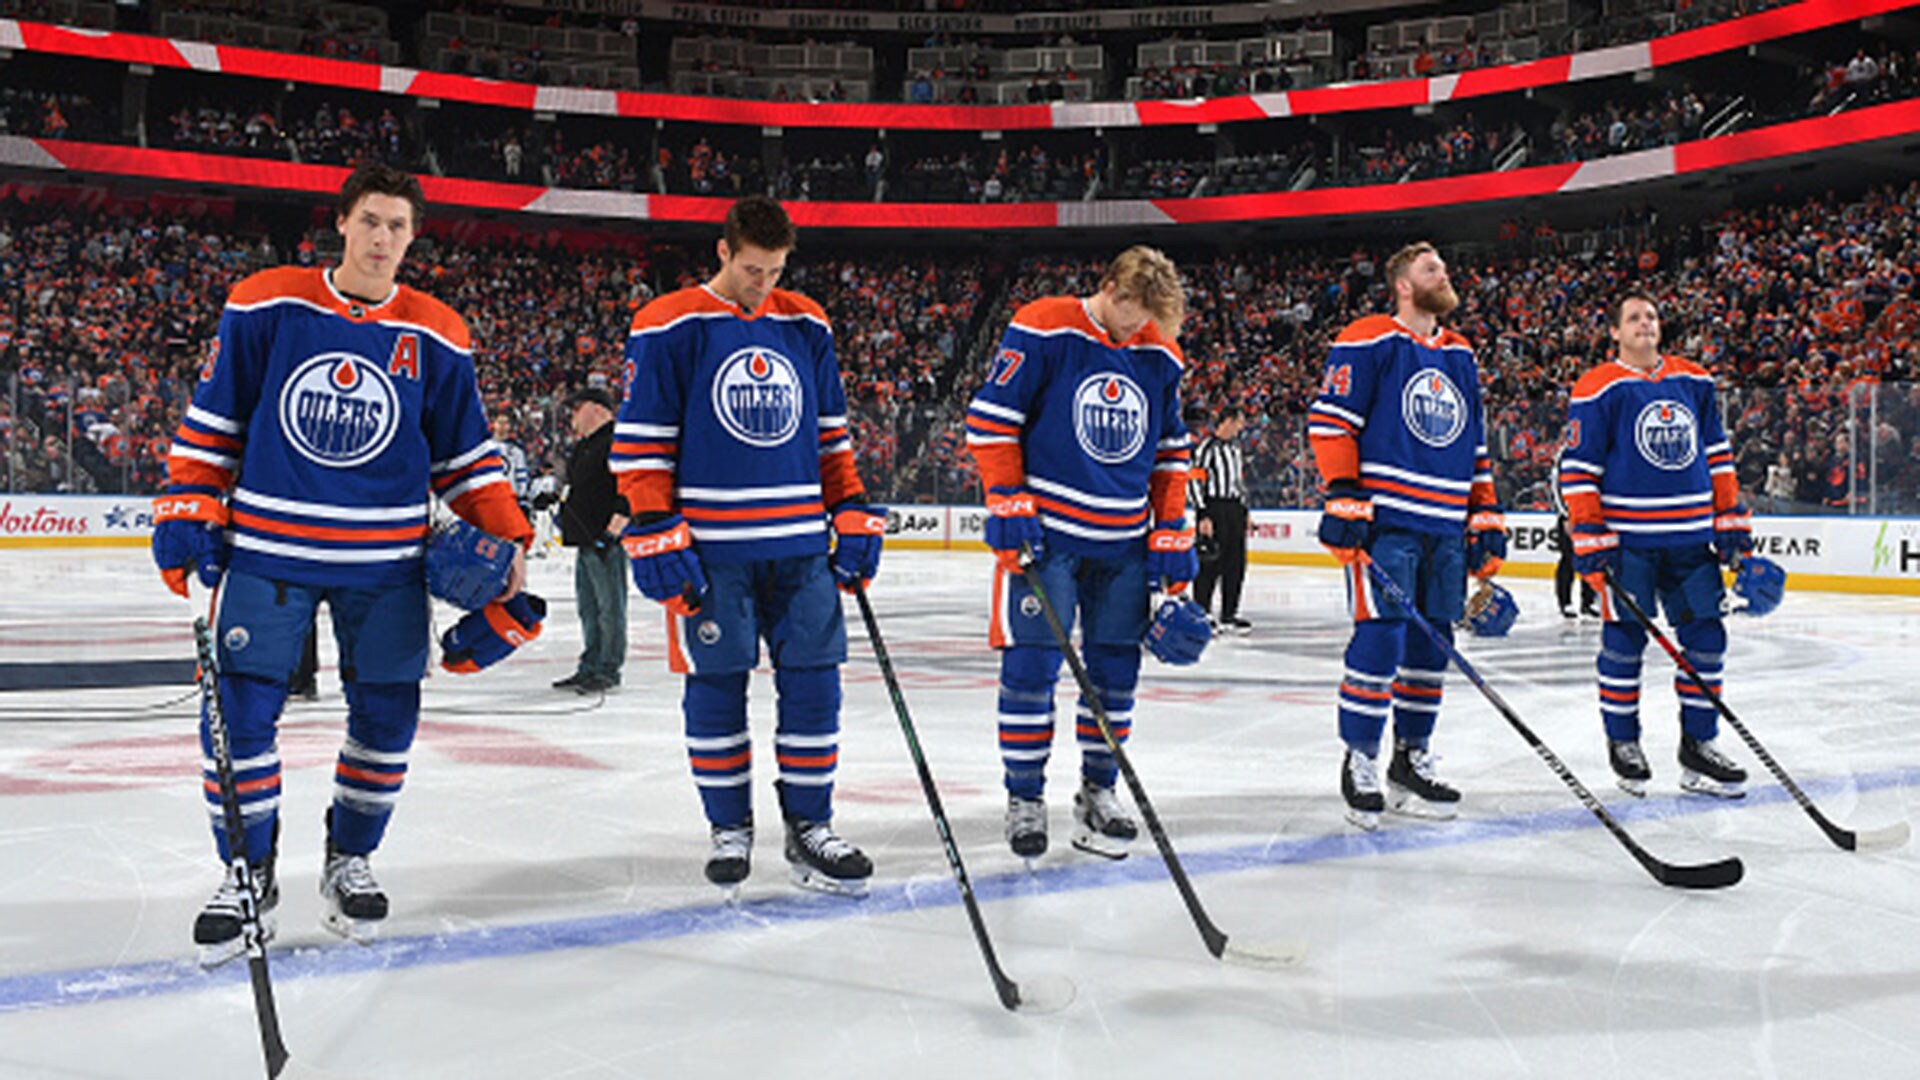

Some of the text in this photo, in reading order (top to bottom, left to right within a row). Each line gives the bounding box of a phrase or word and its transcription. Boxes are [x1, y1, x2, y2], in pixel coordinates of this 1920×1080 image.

[388, 333, 420, 381] A
[300, 389, 383, 430] OILERS
[726, 383, 793, 410] OILERS
